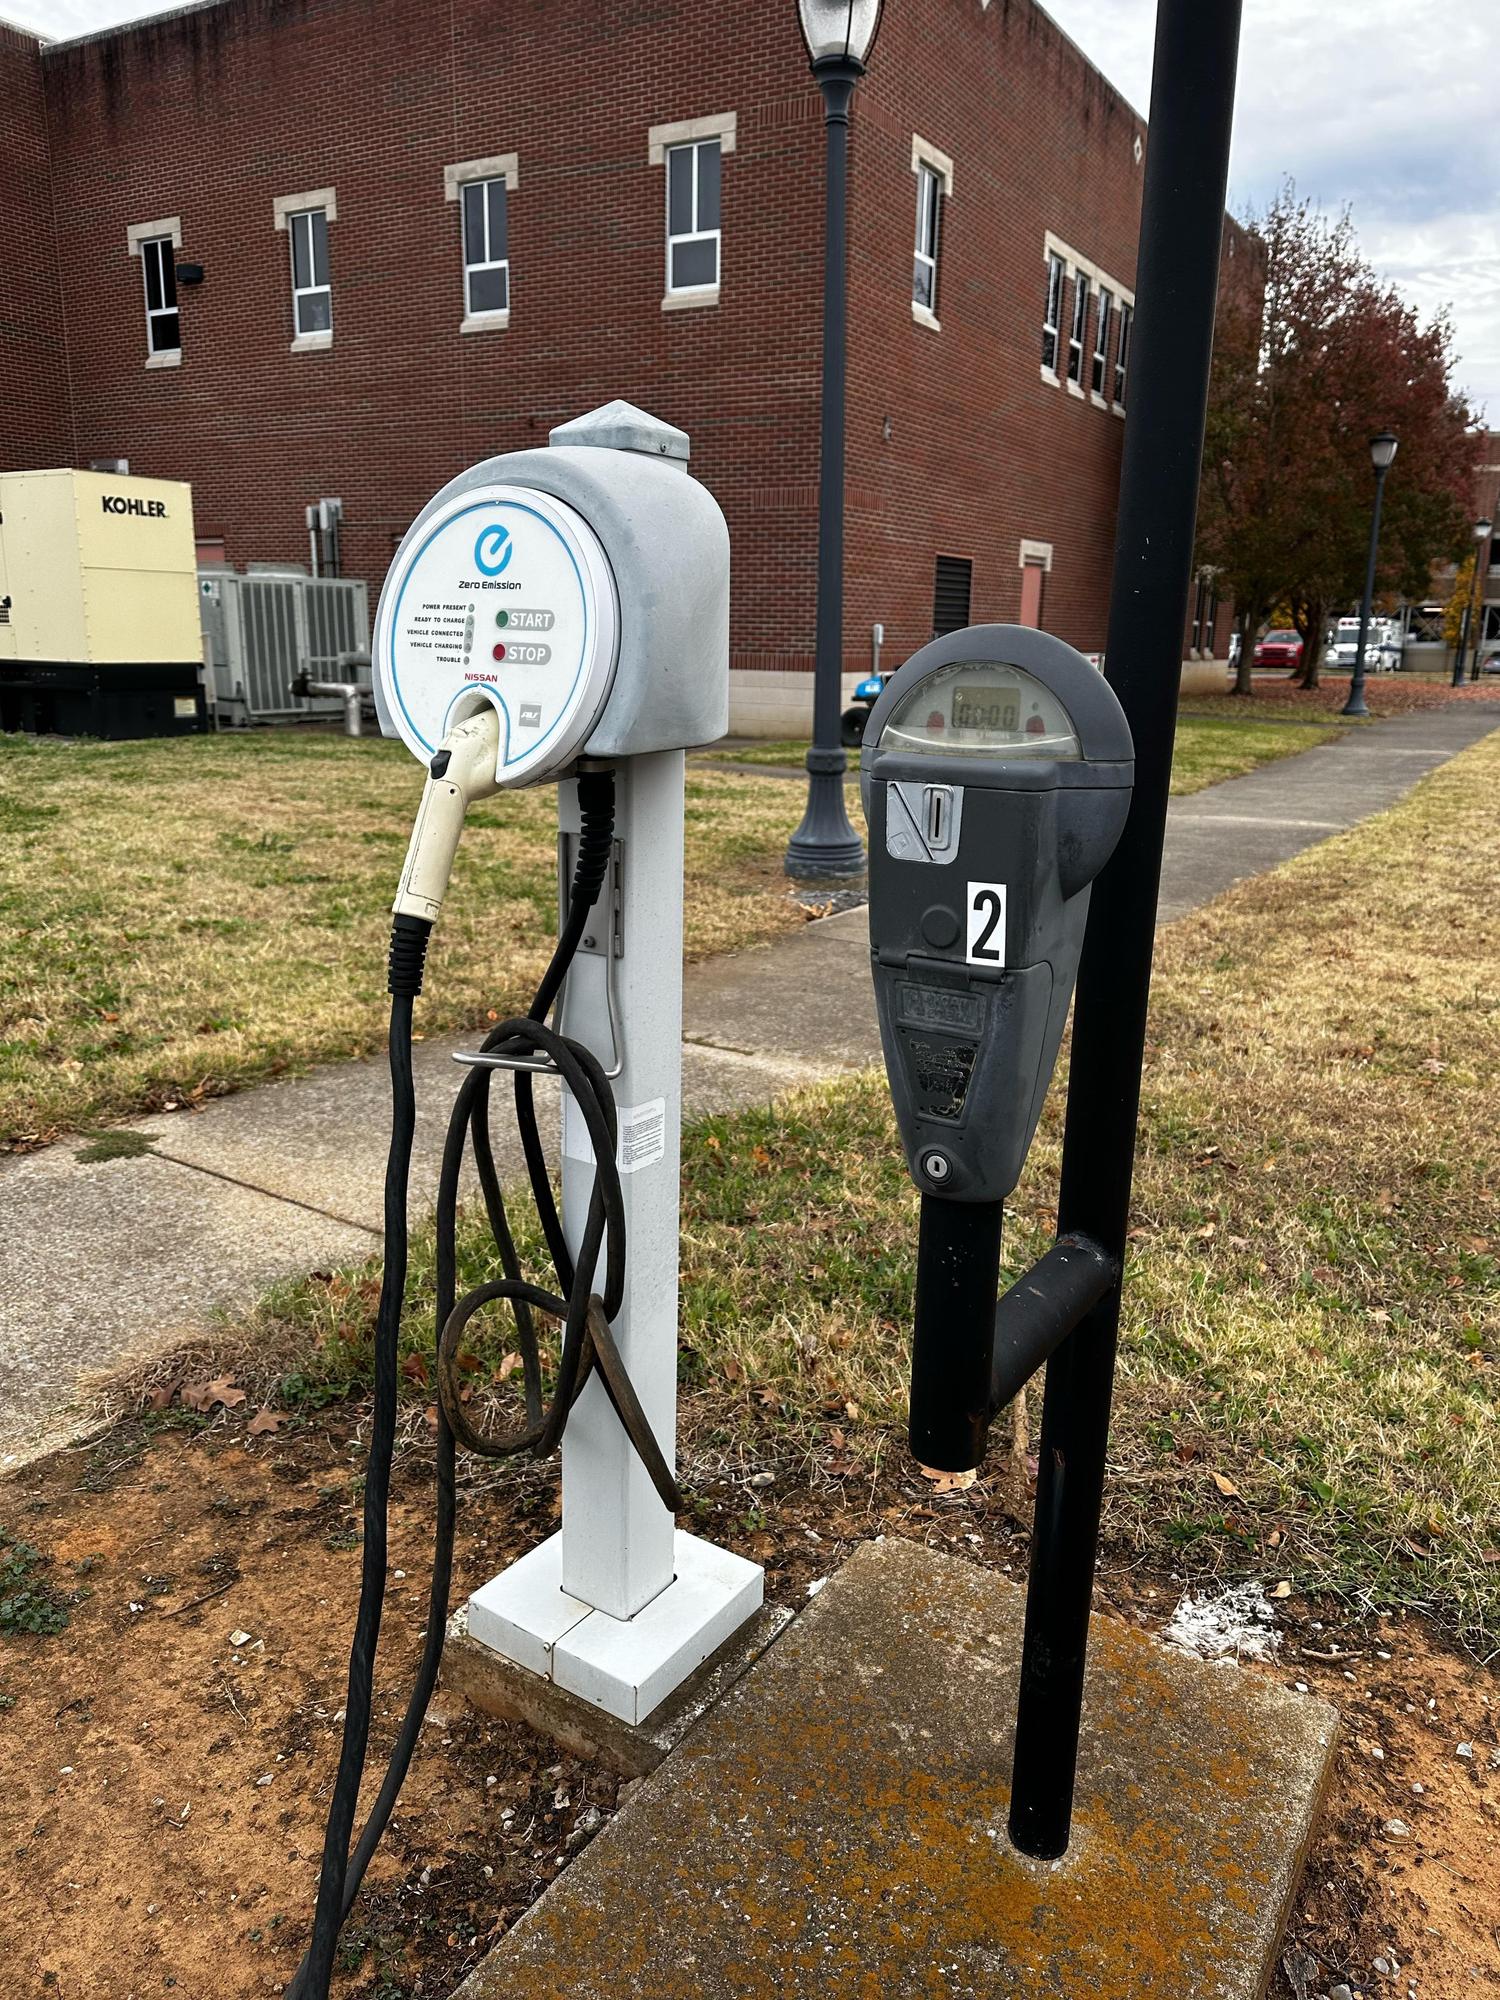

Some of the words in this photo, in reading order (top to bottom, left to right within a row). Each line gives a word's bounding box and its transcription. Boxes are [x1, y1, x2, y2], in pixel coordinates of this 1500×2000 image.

[102, 495, 166, 518] KOHLER
[458, 580, 480, 589] Zero
[481, 581, 522, 590] Emission
[510, 612, 552, 627] START
[508, 646, 546, 661] STOP
[464, 673, 498, 682] NISSAN
[972, 889, 1001, 960] 2
